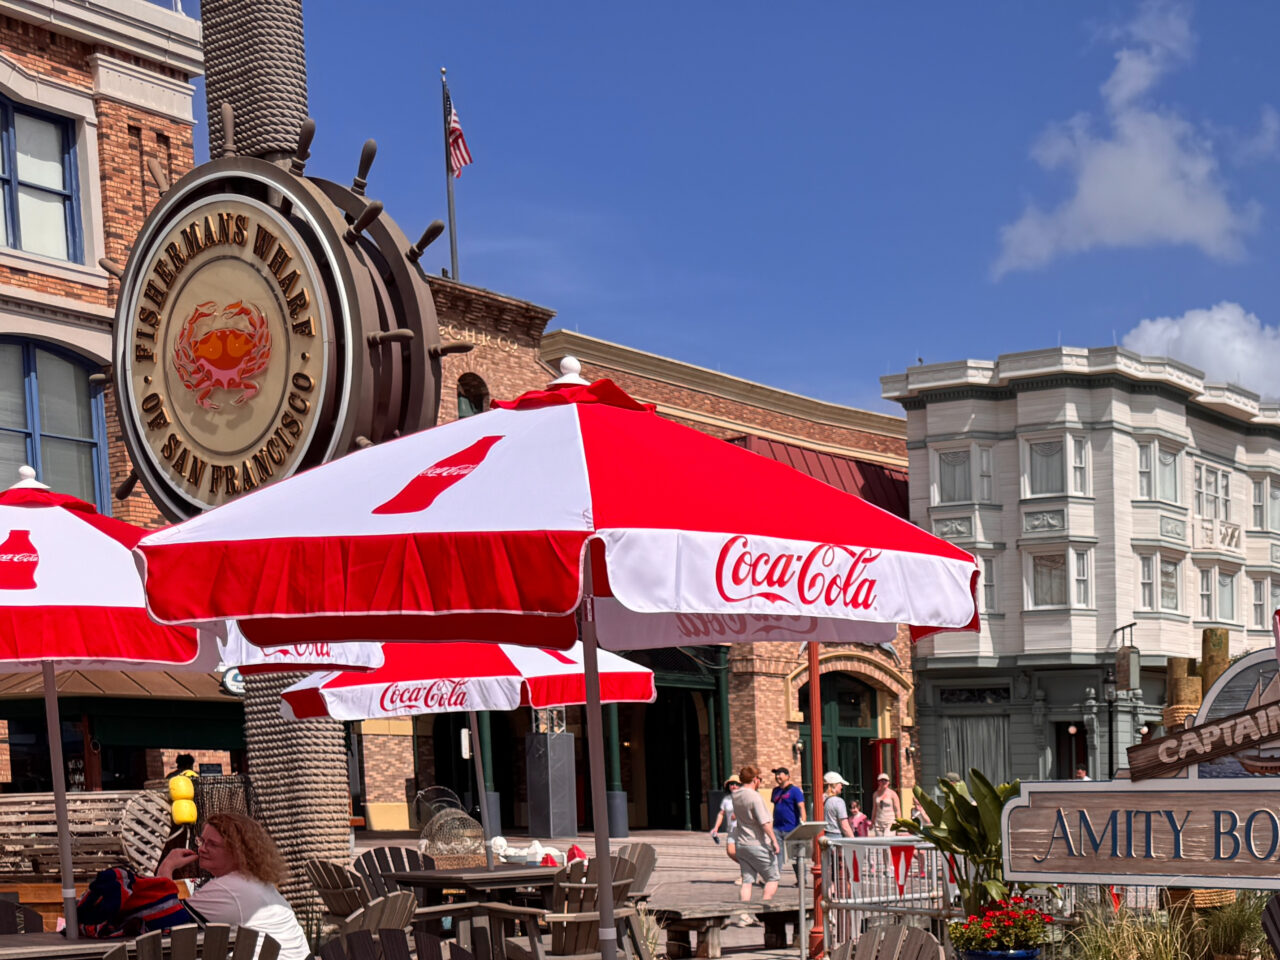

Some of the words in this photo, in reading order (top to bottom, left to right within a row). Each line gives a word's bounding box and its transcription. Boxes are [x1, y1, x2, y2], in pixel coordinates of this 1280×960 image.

[135, 212, 249, 363] FISHERMANS
[252, 223, 316, 337] WHARF
[142, 391, 172, 431] OF
[161, 432, 208, 490] SAN
[209, 371, 315, 497] FRANCISCO
[715, 535, 882, 610] Coca-Cola
[380, 678, 468, 713] Coca-Cola
[1033, 807, 1193, 864] AMITY
